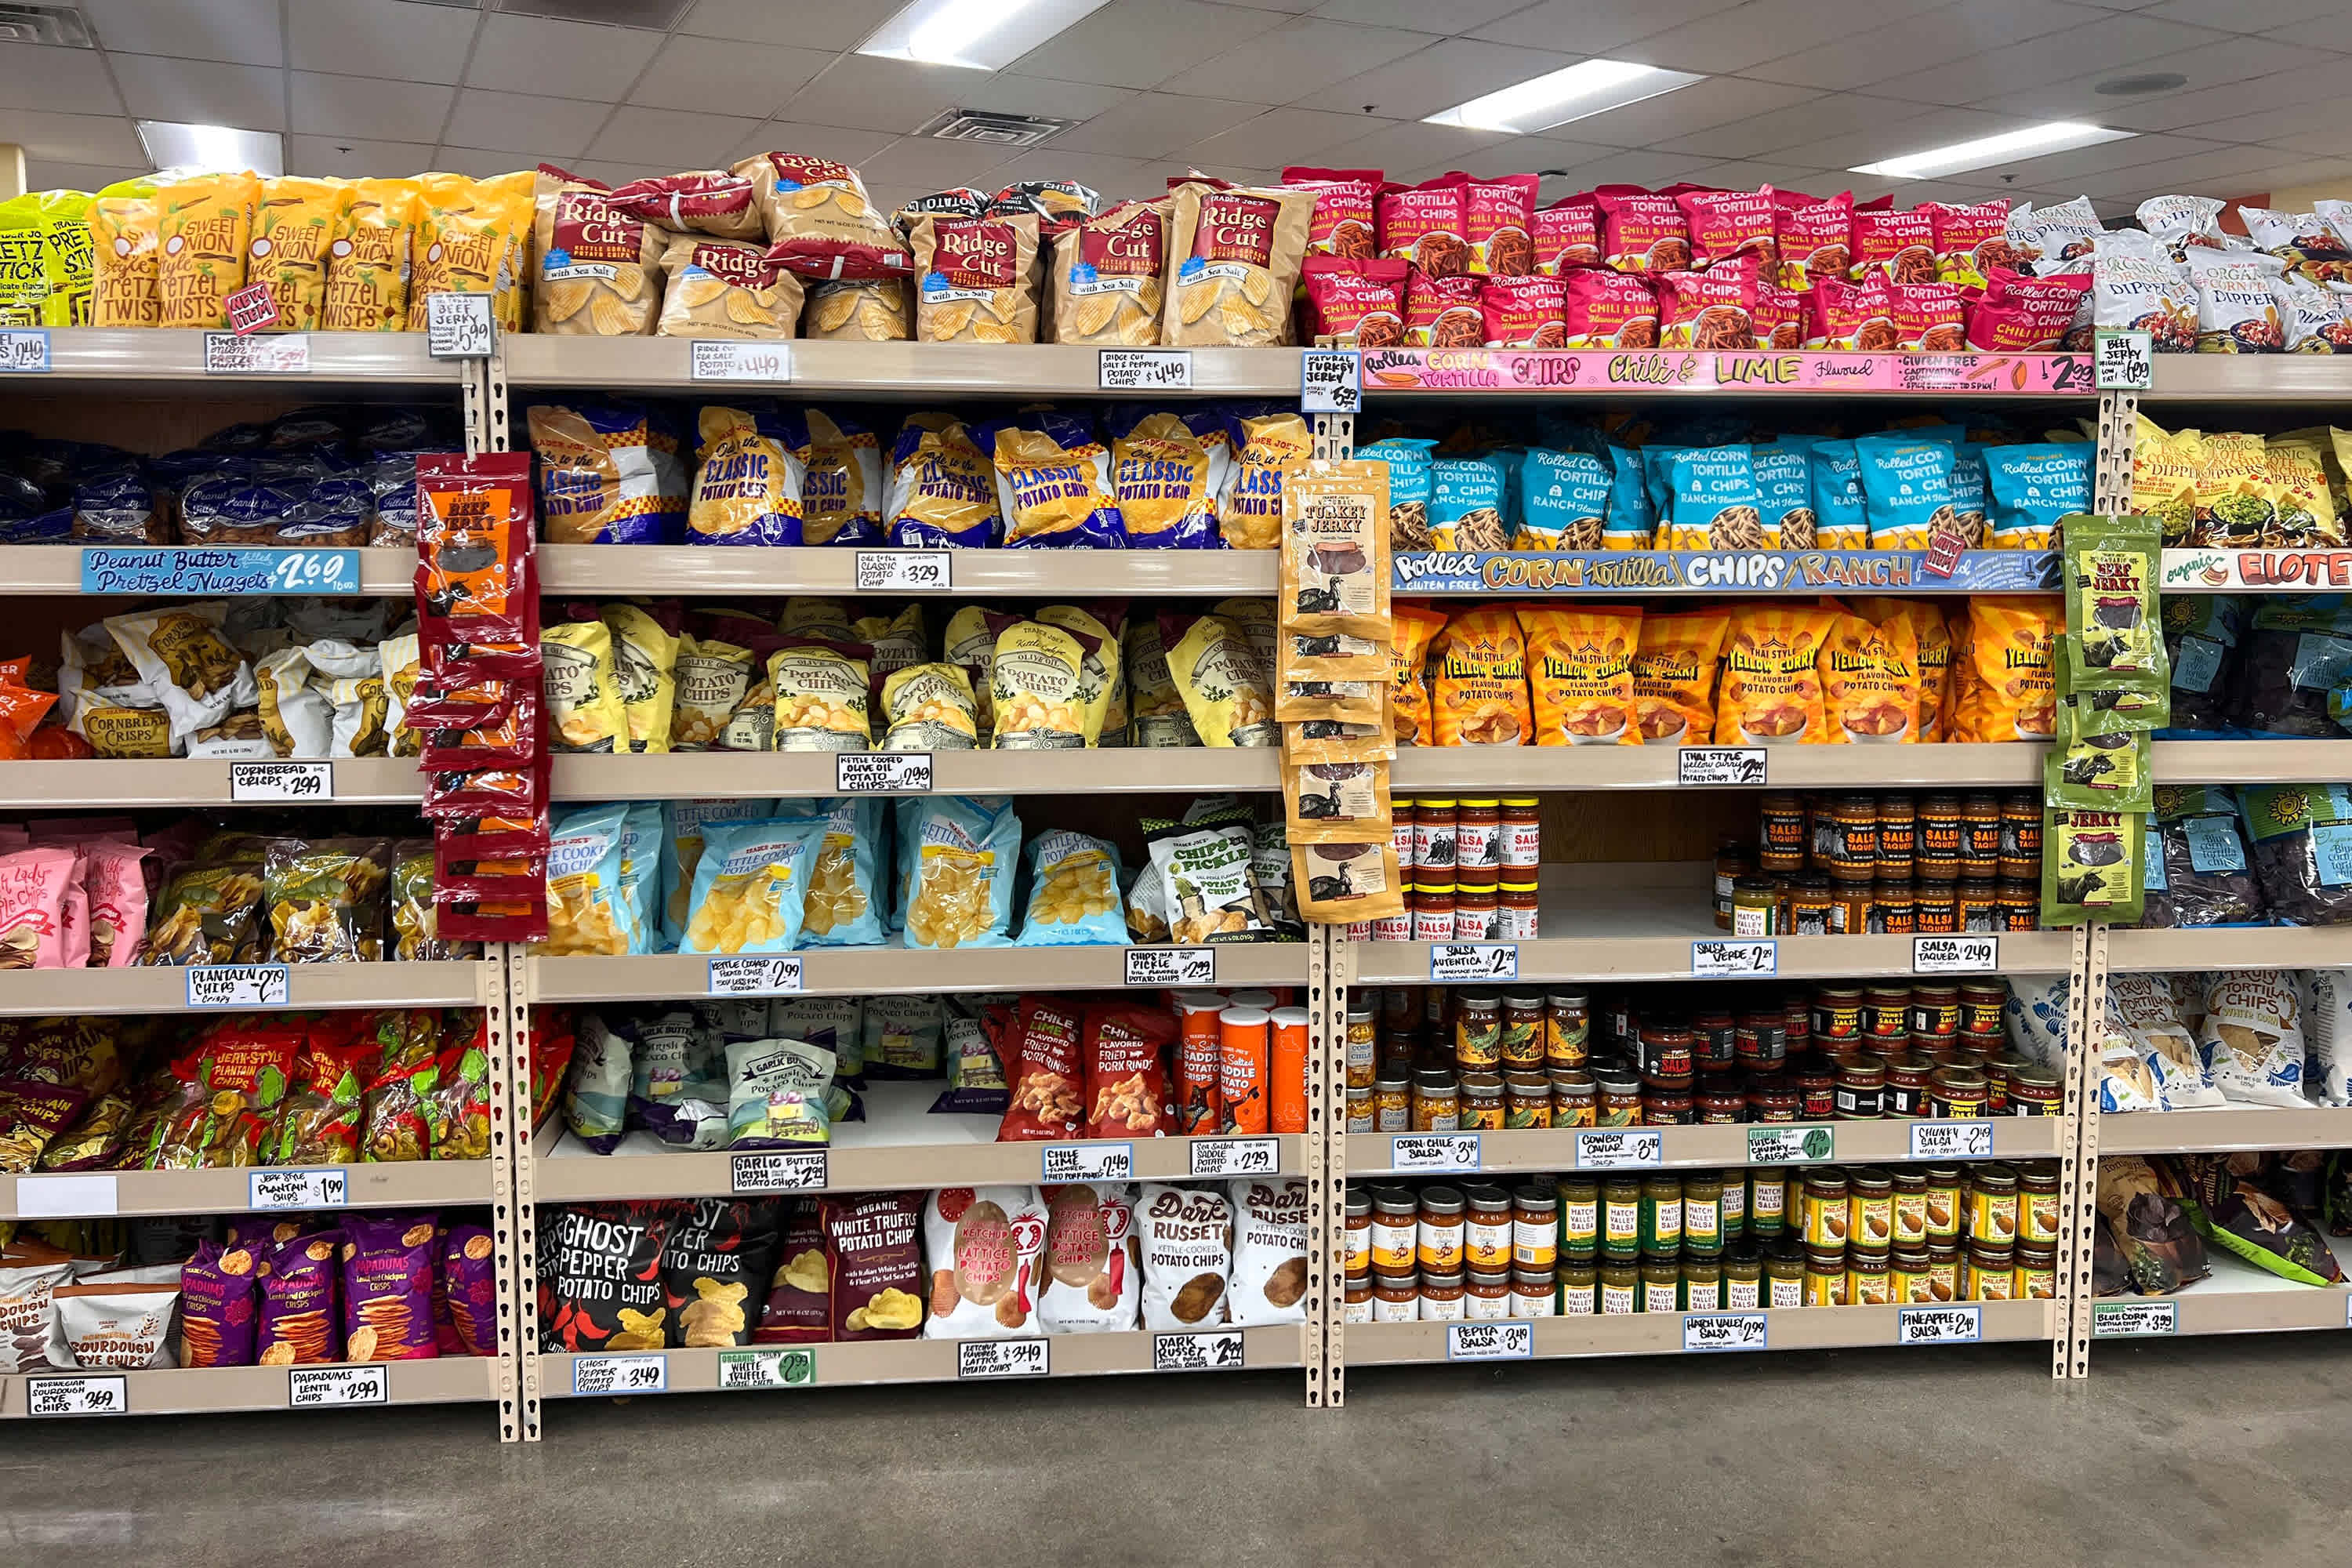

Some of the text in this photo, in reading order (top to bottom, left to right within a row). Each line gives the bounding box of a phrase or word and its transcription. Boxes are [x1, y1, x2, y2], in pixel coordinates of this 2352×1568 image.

[1399, 195, 1458, 205] TORTILLA
[1712, 200, 1772, 212] TORTILLA
[562, 201, 634, 227] Ridge
[1203, 206, 1268, 230] Ridge
[1420, 208, 1457, 219] CHIPS
[1734, 214, 1772, 227] CHIPS
[582, 223, 627, 245] Cut
[1216, 227, 1261, 249] Cut
[942, 230, 1008, 257] Ridge
[962, 253, 1003, 278] Cut
[230, 287, 267, 312] NEW
[236, 301, 274, 329] ITEM
[438, 304, 470, 314] BEEF
[435, 314, 478, 325] JERKY
[210, 337, 255, 347] SWEET
[2107, 339, 2132, 350] BEEF
[1425, 353, 1490, 372] CORN
[2104, 350, 2141, 361] JERKY
[1107, 368, 1140, 378] POTATO
[1308, 361, 1354, 374] TURKEY
[1512, 354, 1874, 385] CHIPS Chili LIME Flavored
[1306, 372, 1344, 384] JERKY
[1421, 370, 1499, 387] TORTILLA
[705, 452, 769, 484] CLASSIC
[1117, 459, 1193, 484] CLASSIC
[2002, 459, 2089, 475] Rolled CORN
[1010, 464, 1083, 490] CLASSIC
[1553, 468, 1613, 486] TORTILLA
[2023, 472, 2089, 485] TORTILLA
[1113, 483, 1191, 502] POTATO CHIP
[2049, 486, 2090, 499] CHIPS
[448, 501, 490, 517] BEEF
[1532, 494, 1576, 510] RANCH
[1305, 505, 1368, 521] TURKEY
[1310, 520, 1362, 534] JERKY
[89, 550, 241, 571] Peanut Butter
[861, 562, 897, 572] CLASSIC
[861, 570, 893, 581] POTATO
[1395, 552, 1482, 584] Rolled
[1482, 557, 1585, 590] CORN
[1584, 557, 1675, 588] tortilla
[1686, 554, 1786, 588] CHIPS
[1799, 554, 1911, 587] RANCH
[2238, 553, 2351, 586] ELOTE
[97, 570, 268, 593] Pretzel Nuggets
[1444, 656, 1525, 680] YELLOW CURRY
[1725, 649, 1819, 673] YELLOW CURRY
[1006, 668, 1068, 687] POTATO
[1015, 678, 1062, 695] CHIPS
[89, 714, 169, 731] CORNBREAD
[105, 729, 151, 743] CRISPS
[235, 765, 307, 776] CORNBREAD
[843, 772, 886, 782] POTATO
[238, 776, 283, 787] CRISPS
[849, 782, 884, 790] CHIPS
[2071, 812, 2122, 828] JERKY
[1769, 823, 1803, 836] SALSA
[1174, 840, 1229, 862] CHIPS
[1182, 848, 1250, 872] PICKLE
[1417, 921, 1452, 935] SALSA
[1921, 942, 1957, 952] SALSA
[1133, 960, 1170, 970] PICKLE
[1432, 956, 1482, 968] AUTENTICA
[192, 968, 256, 984] PLANTAIN
[196, 982, 234, 996] CHIPS
[2223, 981, 2288, 1003] TORTILLA
[2226, 993, 2280, 1014] CHIPS
[217, 1048, 283, 1065] JERK-STYLE
[1099, 1050, 1127, 1062] FRIED
[215, 1064, 257, 1078] PLANTAIN
[1098, 1058, 1154, 1073] PORK RINDS
[214, 1076, 249, 1092] CHIPS
[1583, 1134, 1624, 1145] COWBOY
[1919, 1127, 1958, 1138] CHUNKY
[1921, 1137, 1951, 1146] SALSA
[1046, 1149, 1078, 1159] CHILE
[1409, 1147, 1443, 1158] SALSA
[1751, 1146, 1788, 1156] CHUNKY
[735, 1157, 782, 1170] GARLIC
[1047, 1158, 1079, 1167] LIME
[737, 1169, 768, 1179] IRISH
[259, 1181, 307, 1196] PLANTAIN
[856, 1200, 898, 1216] ORGANIC
[1149, 1191, 1229, 1223] Dark
[830, 1218, 871, 1237] WHITE
[963, 1228, 1008, 1240] KETCHUP
[1153, 1221, 1223, 1242] RUSSET
[562, 1213, 644, 1258] GHOST
[838, 1232, 884, 1254] POTATO
[957, 1247, 1009, 1259] LATTICE
[358, 1257, 410, 1273] PAPADUMS
[559, 1247, 630, 1282] PEPPER
[1151, 1253, 1225, 1268] POTATO CHIPS
[964, 1272, 1001, 1284] CHIPS
[557, 1275, 661, 1305] POTATO CHIPS
[1902, 1312, 1955, 1326] PINEAPPLE
[2097, 1312, 2147, 1322] BLUE CORN
[1457, 1325, 1498, 1338] PEPITA
[1699, 1327, 1730, 1339] SALSA
[1911, 1325, 1941, 1338] SALSA
[71, 1340, 155, 1355] SOURDOUGH
[1159, 1335, 1196, 1348] DARK
[1460, 1336, 1497, 1349] SALSA
[1159, 1345, 1206, 1359] RUSSET
[77, 1354, 145, 1367] RYE CHIPS
[579, 1359, 611, 1368] GHOST
[294, 1371, 352, 1384] PAPADUMS
[578, 1367, 618, 1377] PEPPER
[37, 1380, 85, 1388] NORWEGIAN
[299, 1382, 332, 1393] LENTIL
[578, 1376, 615, 1386] POTATO
[34, 1386, 85, 1396] SOURDOUGH
[42, 1394, 66, 1403] RYE
[296, 1394, 323, 1403] CHIPS
[34, 1402, 71, 1413] CHIPS
